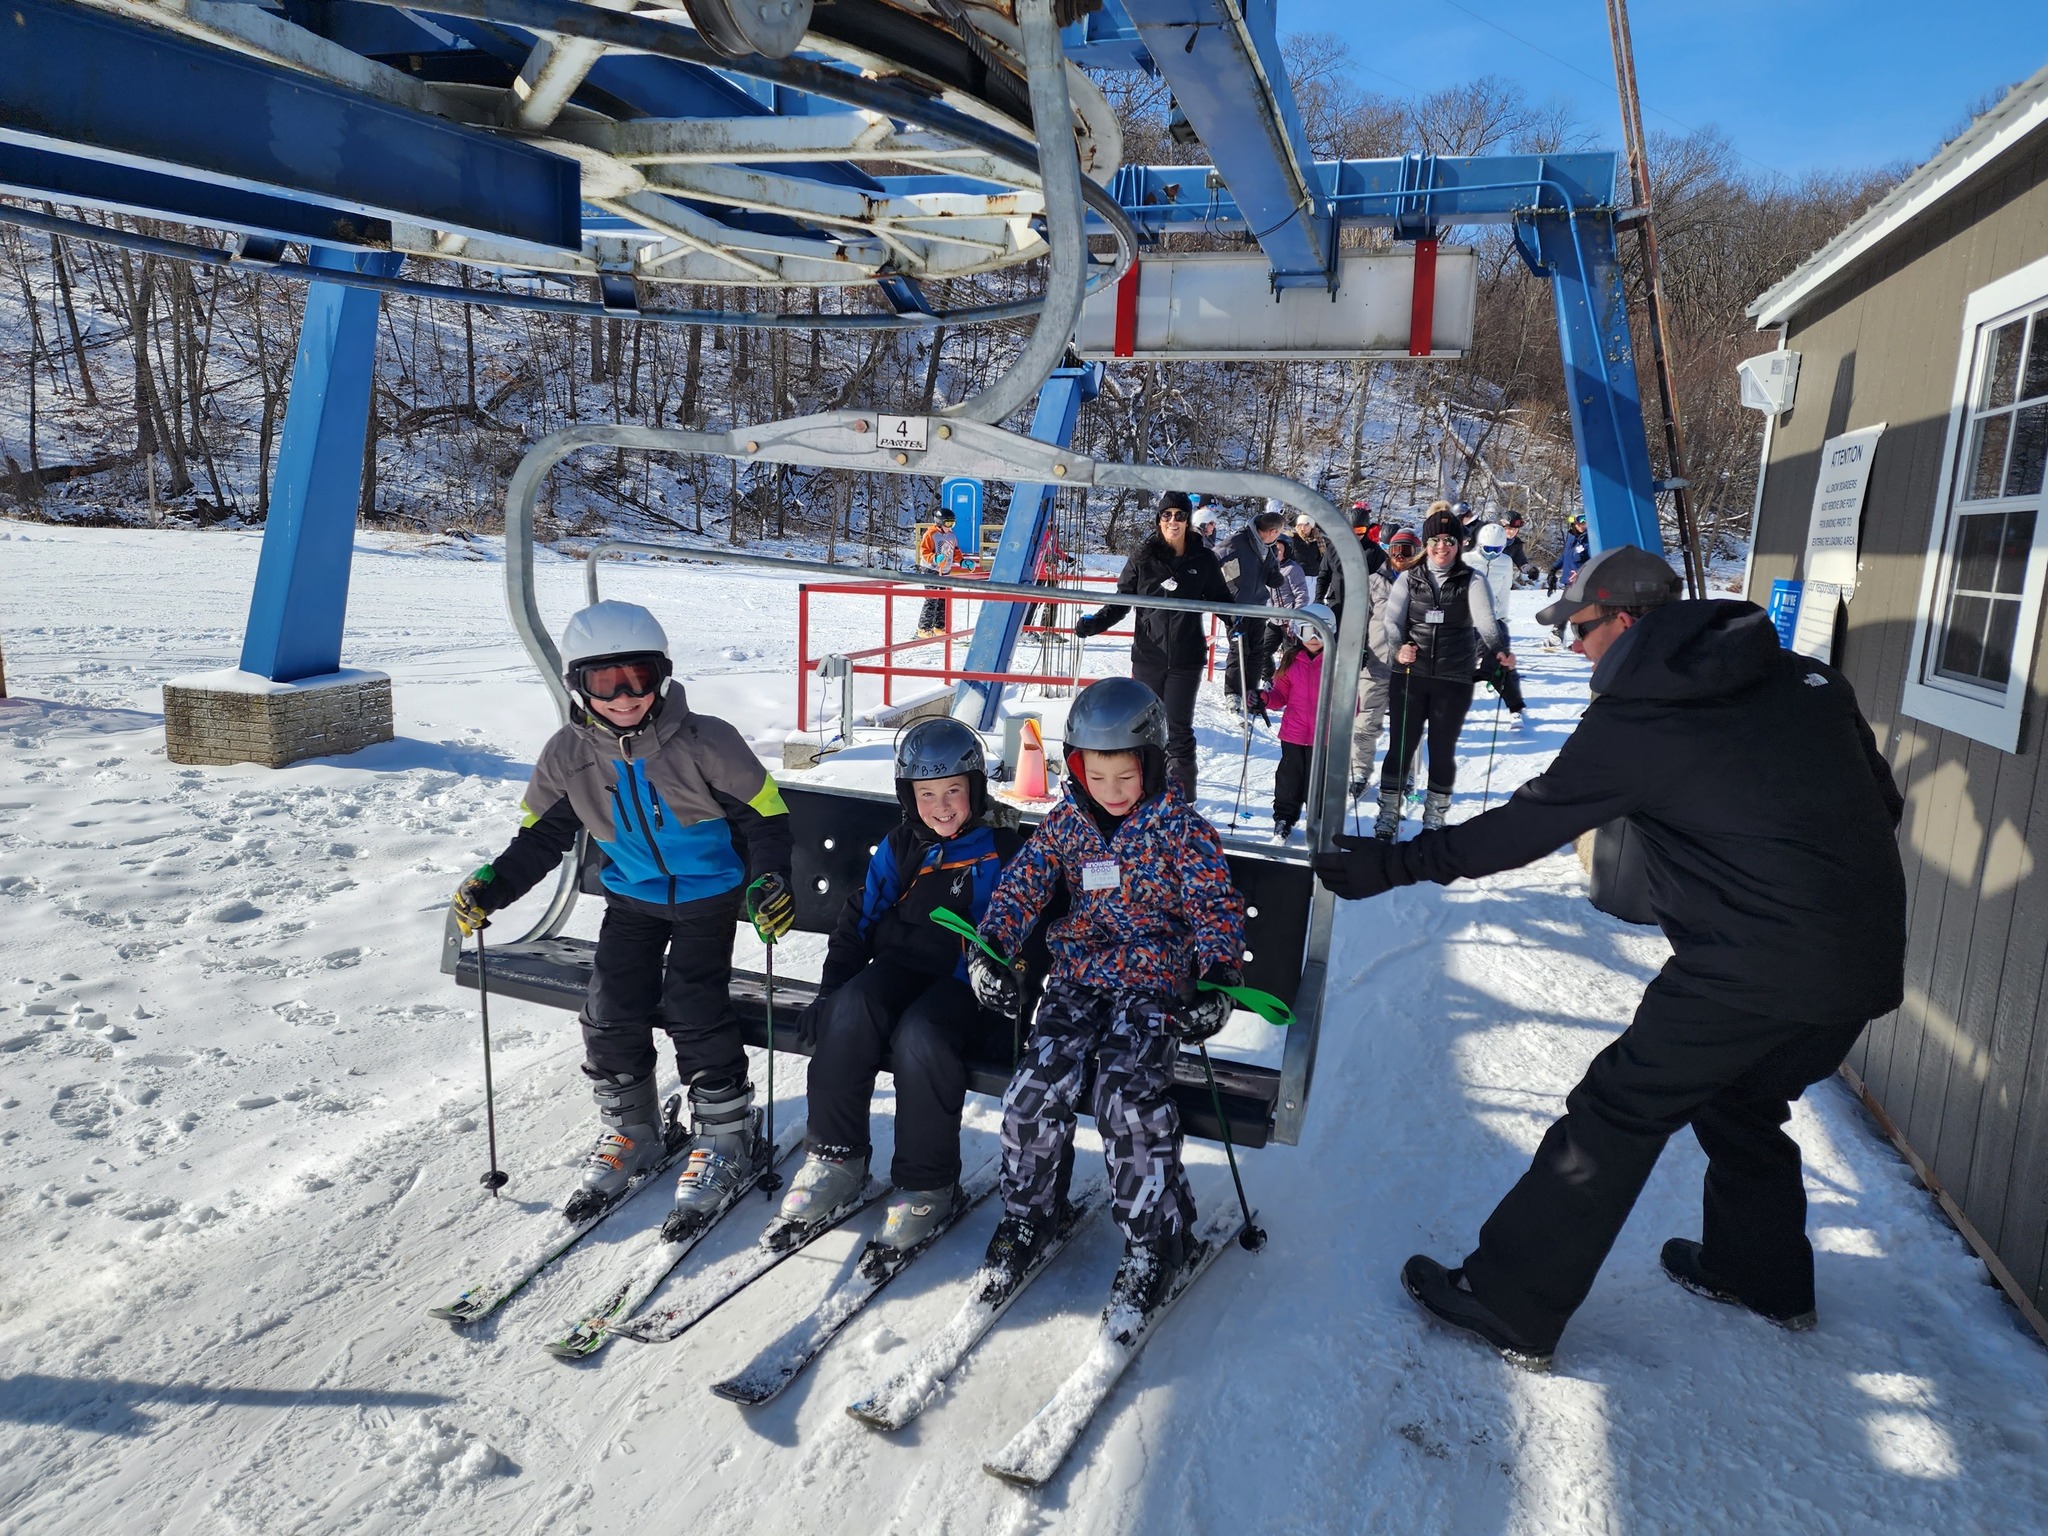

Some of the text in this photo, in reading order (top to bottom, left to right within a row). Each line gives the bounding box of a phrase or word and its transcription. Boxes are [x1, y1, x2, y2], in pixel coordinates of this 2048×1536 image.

[896, 420, 908, 437] 4
[880, 438, 924, 448] PARTEK
[1831, 444, 1864, 468] ATTENTION
